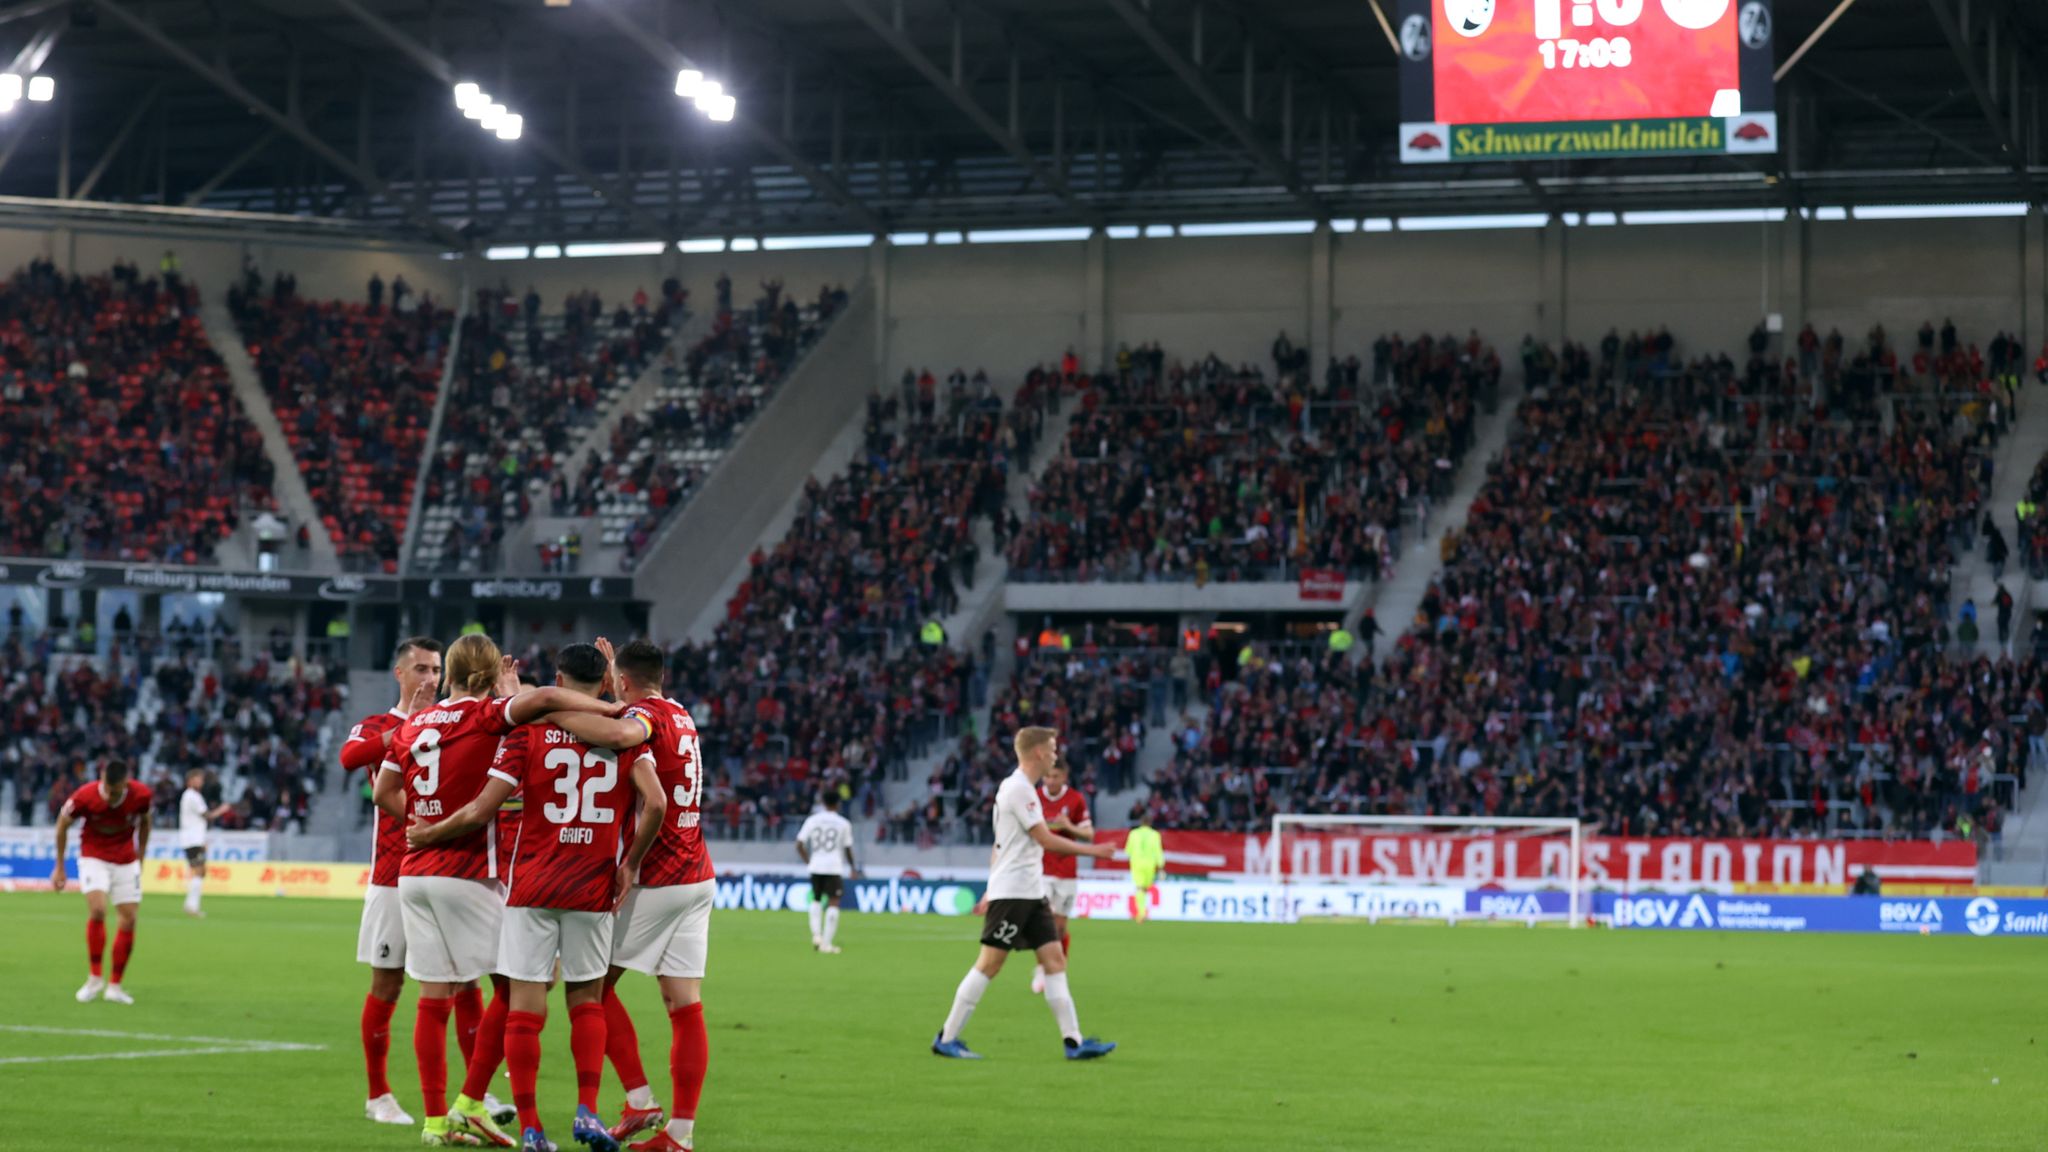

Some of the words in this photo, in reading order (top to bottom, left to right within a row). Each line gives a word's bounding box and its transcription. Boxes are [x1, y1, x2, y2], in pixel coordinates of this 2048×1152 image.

[1454, 118, 1720, 155] Schwarzwaldmilch
[124, 566, 197, 591] Freiburg
[410, 728, 442, 796] 9
[543, 747, 619, 824] 32
[559, 826, 593, 844] GRIFO
[854, 877, 935, 914] wlw
[993, 920, 1018, 945] 32
